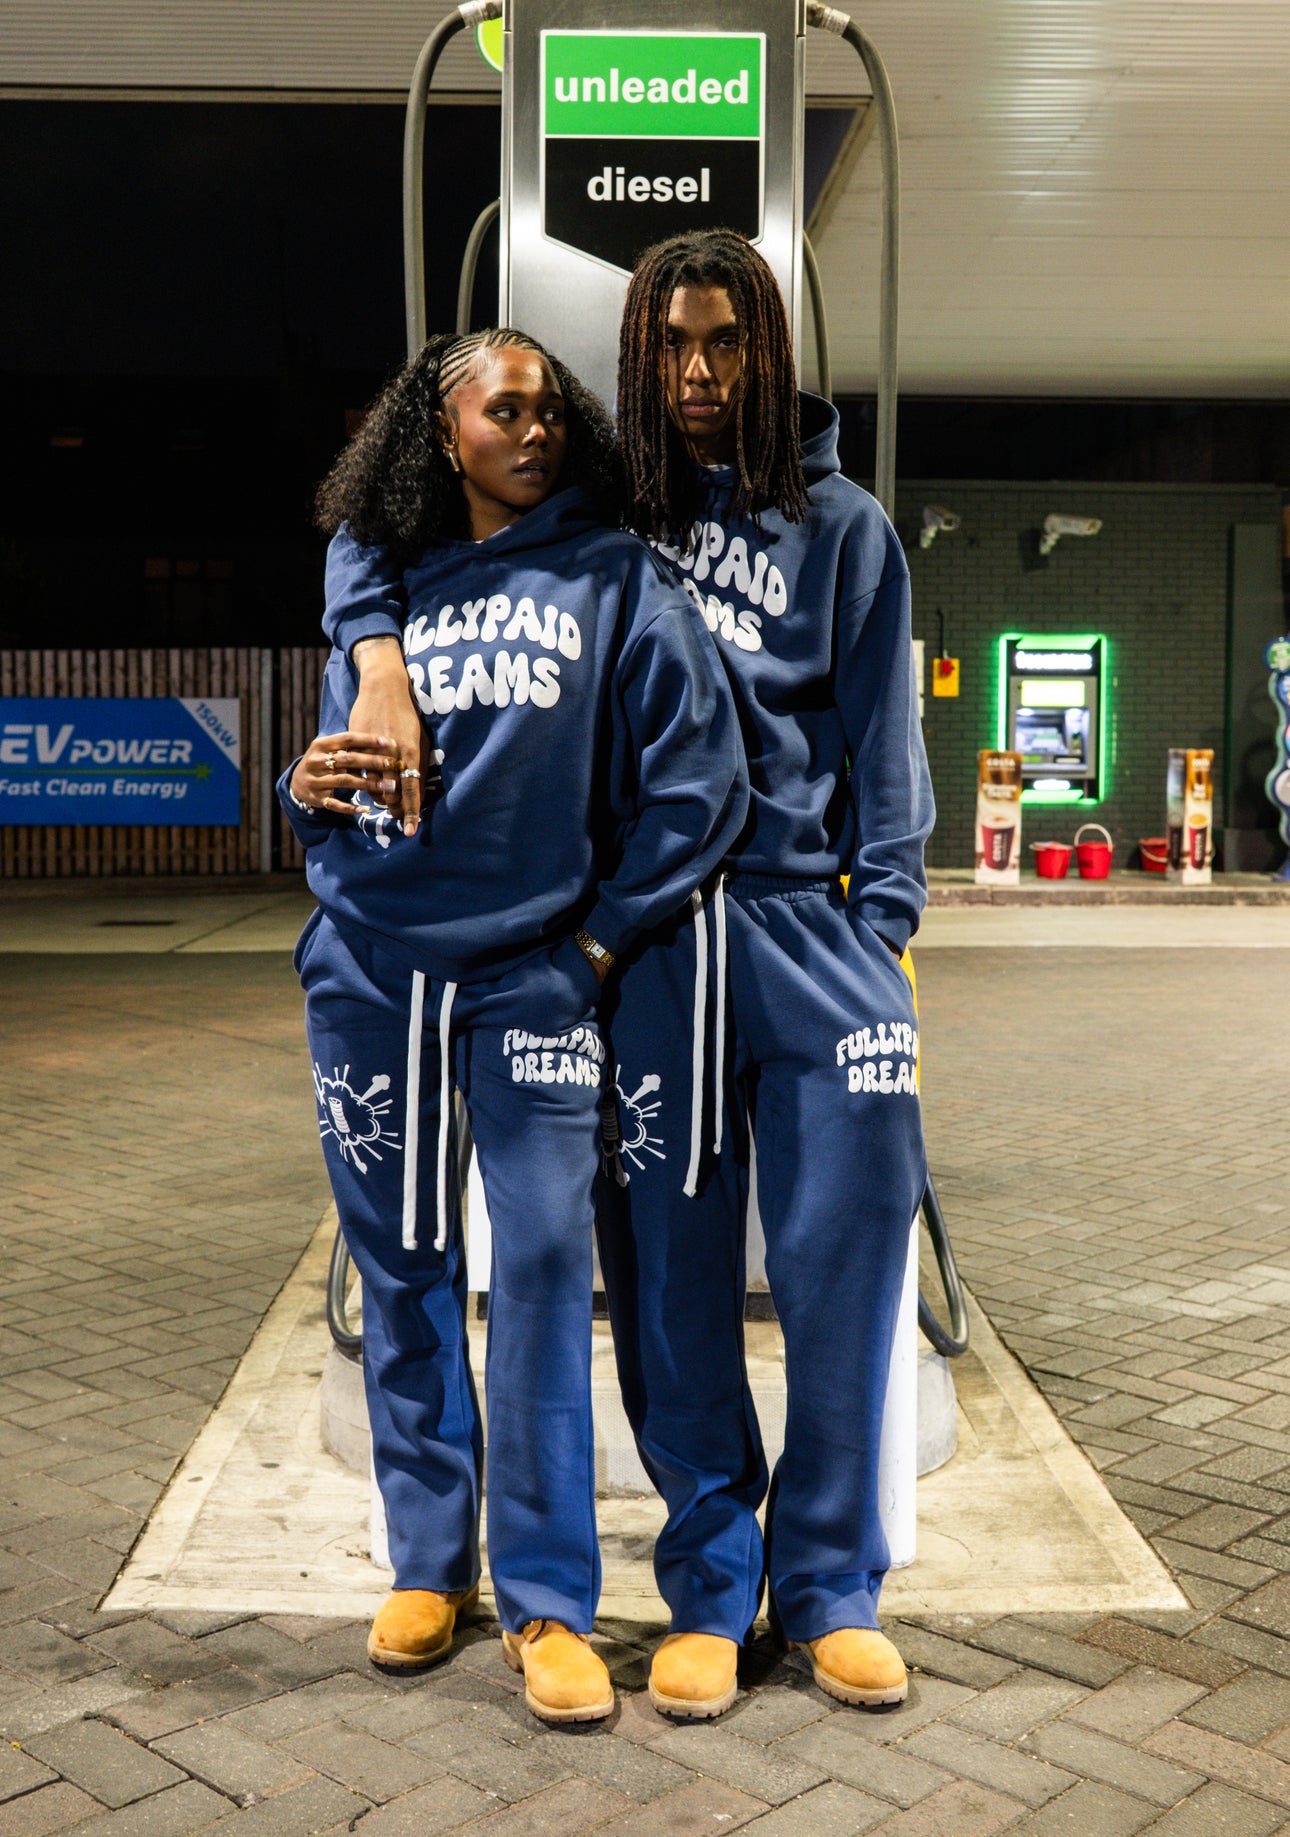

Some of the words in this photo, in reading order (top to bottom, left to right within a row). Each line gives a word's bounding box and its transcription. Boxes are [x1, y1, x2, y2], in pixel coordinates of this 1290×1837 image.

[554, 68, 749, 104] unleaded
[587, 167, 711, 203] diesel
[406, 650, 560, 715] REAMS
[196, 701, 238, 747] 150kW
[0, 779, 41, 796] Fast
[46, 779, 107, 796] Clean
[112, 779, 188, 799] Energy
[512, 1052, 600, 1088] DREAMS
